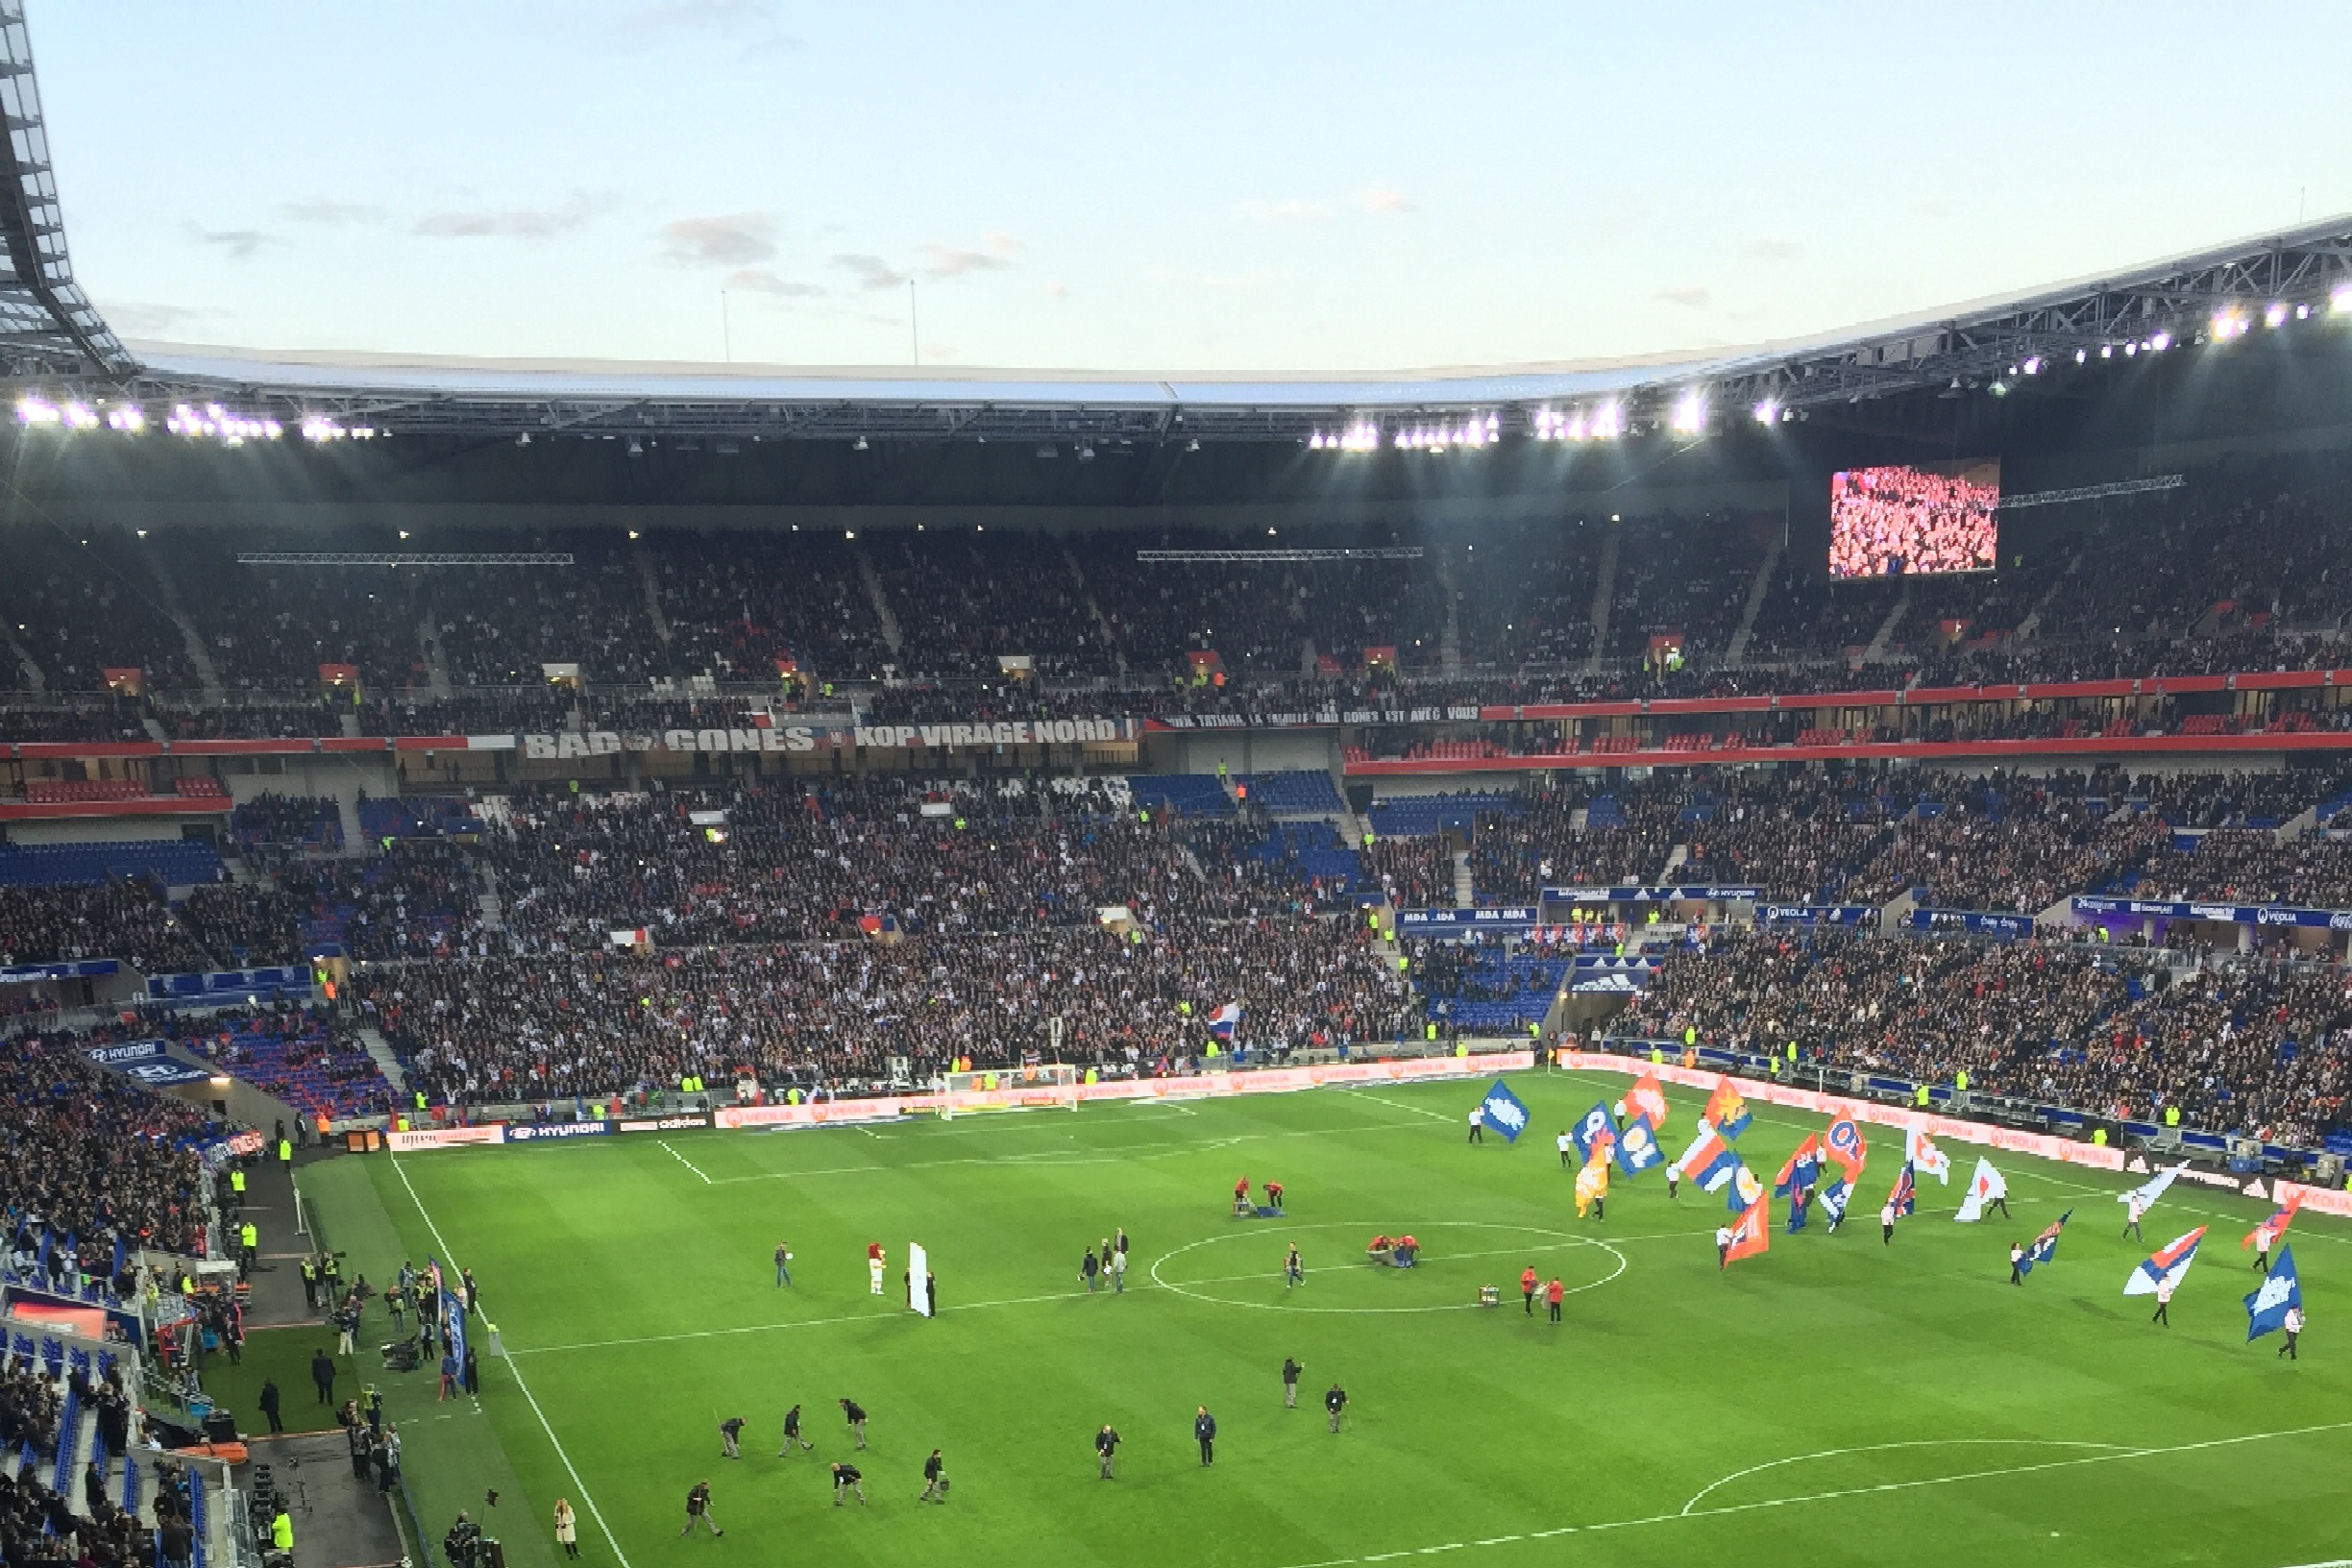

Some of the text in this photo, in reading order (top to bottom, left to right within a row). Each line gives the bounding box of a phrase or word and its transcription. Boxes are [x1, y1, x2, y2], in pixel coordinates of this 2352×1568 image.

[1447, 706, 1479, 720] VOUS
[854, 719, 1116, 747] KOP VIRAGE NORD
[525, 727, 815, 758] BAD GONES
[1778, 908, 1809, 917] VEOLA
[109, 1042, 156, 1060] HYUNDAI
[746, 1111, 794, 1123] VEOLIA
[829, 1105, 878, 1116] VEOLIA
[539, 1123, 604, 1137] HYUNDAI
[659, 1118, 707, 1129] adidas
[2005, 1134, 2041, 1151] VEOLIA
[2075, 1148, 2113, 1164] VEOLIA
